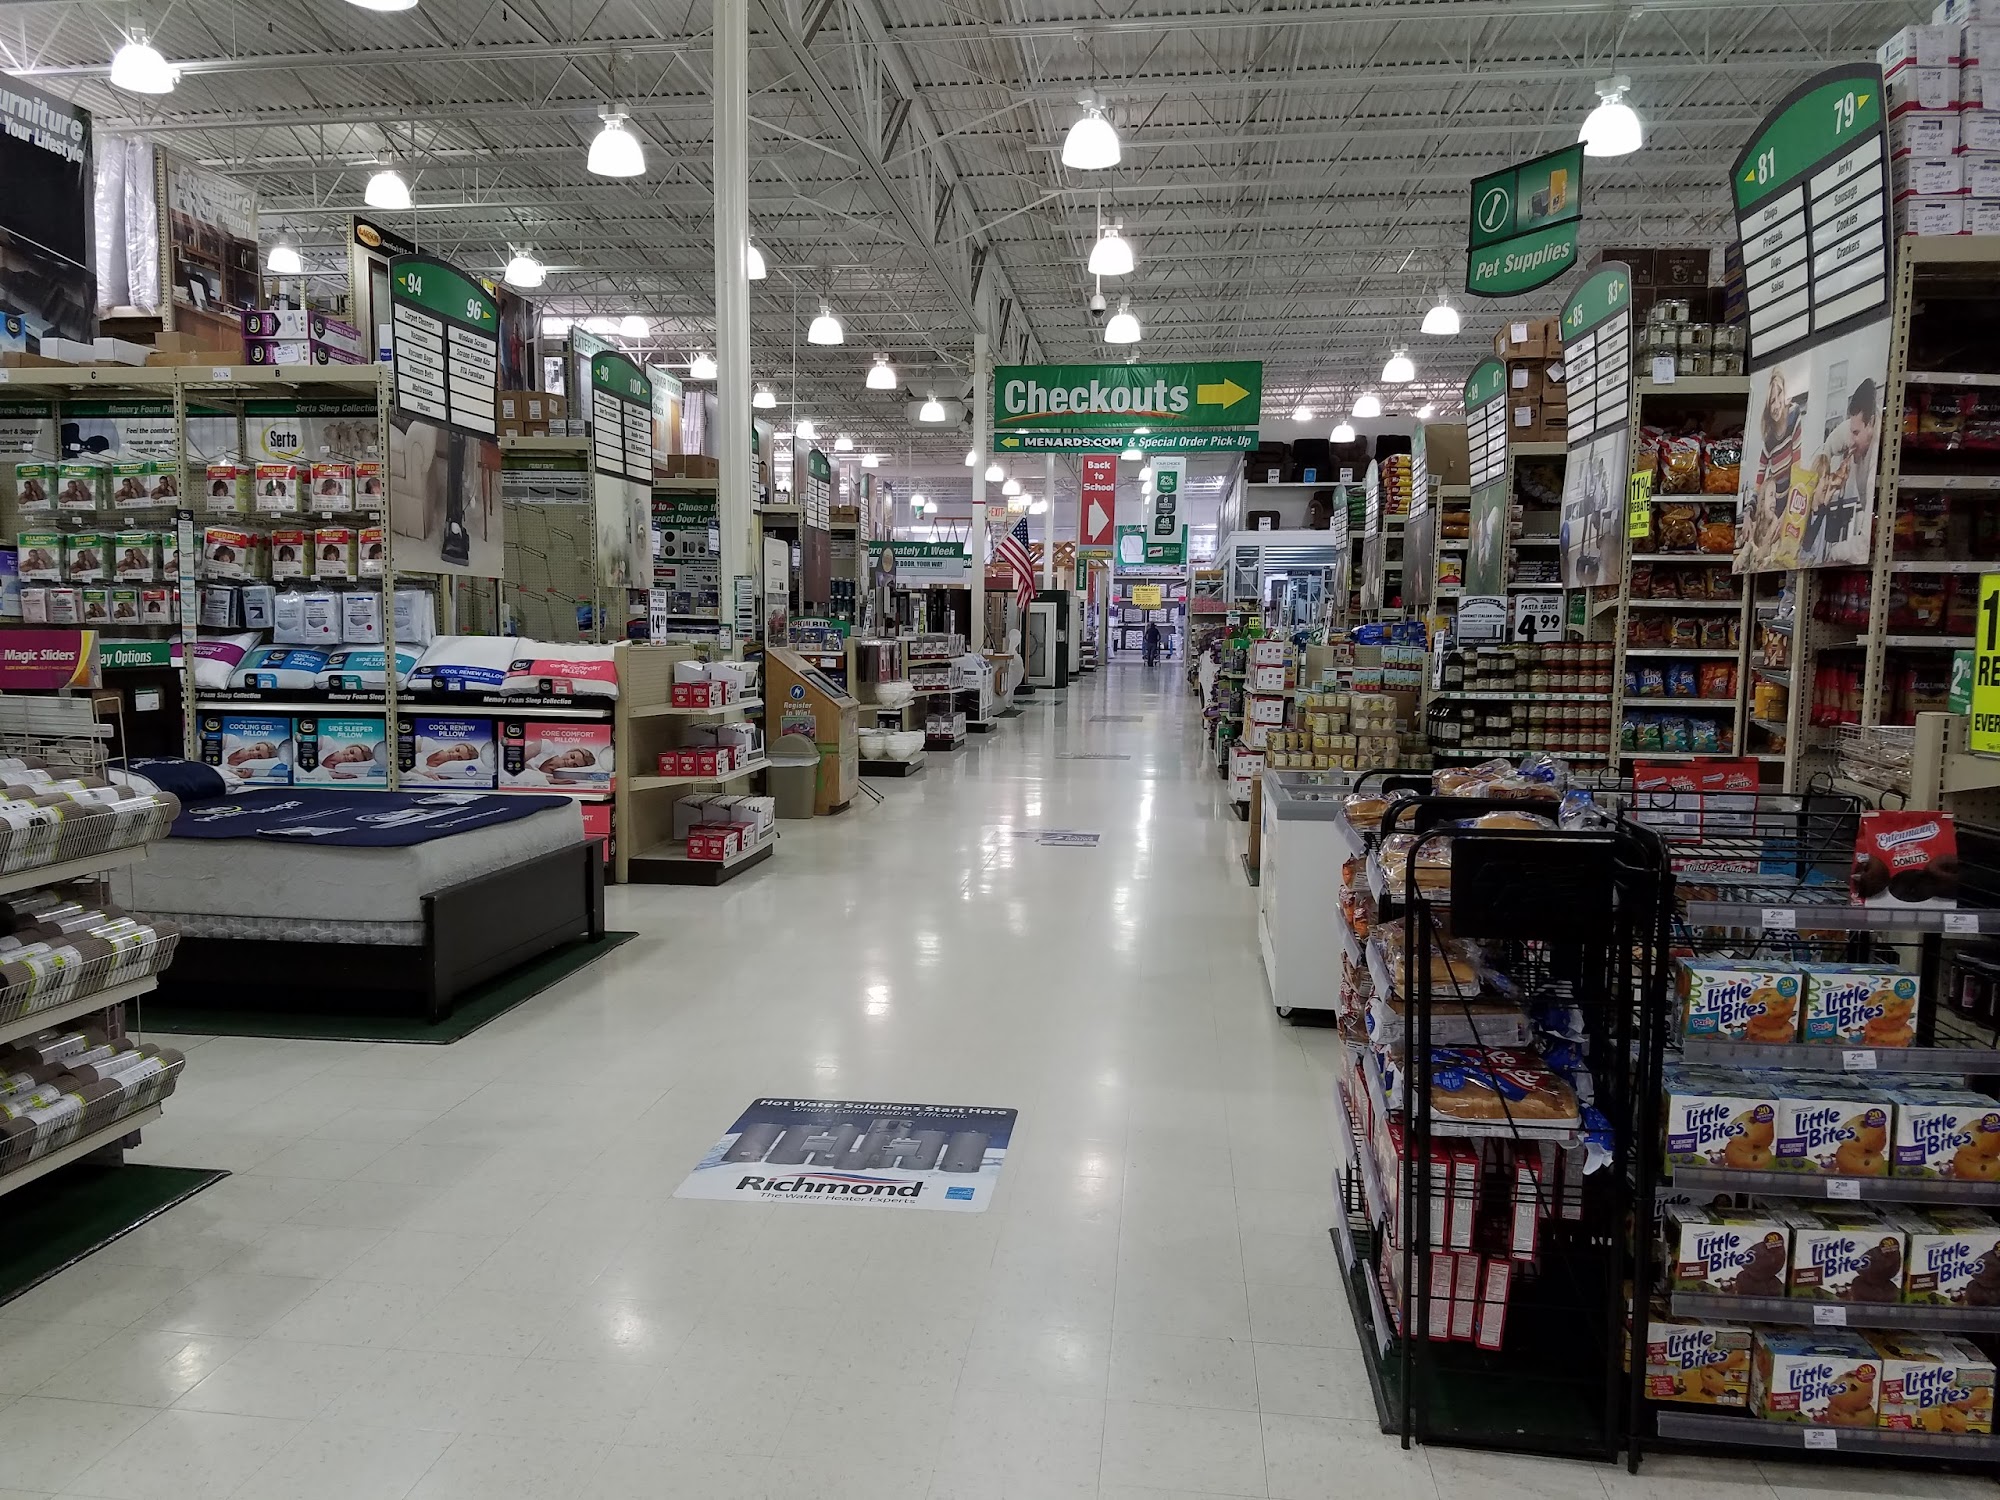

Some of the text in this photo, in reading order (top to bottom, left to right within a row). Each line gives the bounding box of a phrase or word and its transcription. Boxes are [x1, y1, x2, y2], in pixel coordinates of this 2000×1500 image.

[0, 88, 83, 142] urniture
[1833, 91, 1855, 135] 79
[4, 116, 84, 163] Your Lifestyle
[1758, 147, 1775, 185] 81
[1836, 159, 1853, 177] Jerky
[1834, 184, 1858, 206] Sausage
[1836, 213, 1858, 233] Cookies
[1762, 230, 1783, 249] Pretzels
[1836, 240, 1860, 260] Crackers
[1476, 241, 1571, 281] Pet Supplies
[1770, 256, 1782, 270] Dips
[407, 272, 422, 296] 94
[1607, 279, 1618, 305] 83
[1770, 279, 1785, 293] Salsa
[466, 298, 482, 321] 96
[1572, 303, 1583, 328] 85
[404, 310, 435, 330] Carpet Cleaners
[410, 330, 428, 344] Vacuums
[275, 369, 281, 377] B
[600, 364, 609, 382] 98
[412, 382, 434, 397] Mattresses
[629, 378, 641, 395] 100
[1004, 379, 1189, 414] Checkouts
[108, 405, 161, 415] Memory Foam
[295, 404, 317, 413] Serta
[319, 404, 340, 414] Sleep
[270, 430, 297, 447] Serta
[1024, 435, 1252, 448] MENARDS.COM & Special Order Pick-Up
[1087, 461, 1111, 469] Back
[1094, 471, 1105, 480] to
[1083, 483, 1115, 491] School
[1632, 476, 1650, 500] 11%
[677, 502, 708, 512] Choose
[990, 507, 1003, 517] EXIT
[1631, 501, 1650, 513] REBATE
[676, 514, 696, 523] Door
[930, 546, 955, 556] Week
[4, 648, 75, 661] Magic Sliders
[115, 650, 152, 665] Options
[458, 669, 480, 677] RENEW
[329, 693, 351, 701] Memory
[369, 693, 385, 701] Sleep
[483, 695, 506, 704] Memory
[525, 697, 542, 705] Sleep
[543, 697, 572, 705] Collection
[783, 701, 813, 710] Register
[1974, 713, 2000, 733] EVER
[561, 730, 595, 738] COMFORT
[1682, 862, 1709, 872] Moist
[1720, 863, 1752, 874] Tender
[1891, 852, 1930, 868] DONUTS
[1780, 976, 1794, 988] 20
[1897, 979, 1911, 991] 20
[1707, 982, 1752, 1013] Little
[1825, 985, 1870, 1016] Little
[1720, 1001, 1767, 1025] Bites
[1838, 1003, 1884, 1028] Bites
[760, 1099, 1008, 1116] Hot Water Solutions Start Here
[834, 1107, 912, 1117] Comfortable.
[916, 1111, 968, 1119] Efficient.
[1685, 1103, 1730, 1132] Little
[1795, 1108, 1841, 1137] Little
[1698, 1121, 1745, 1144] Bites
[1807, 1125, 1856, 1149] Bites
[1912, 1113, 1957, 1143] Little
[1926, 1131, 1972, 1155] Bites
[735, 1176, 924, 1198] Richmond
[869, 1197, 916, 1205] Experts
[1697, 1231, 1740, 1260] Little
[1811, 1237, 1856, 1266] Little
[1708, 1249, 1756, 1273] Bites
[1824, 1254, 1871, 1278] Bites
[1927, 1242, 1970, 1271] Little
[1939, 1259, 1985, 1284] Bites
[1668, 1330, 1714, 1358] Little
[1680, 1348, 1729, 1371] Bites
